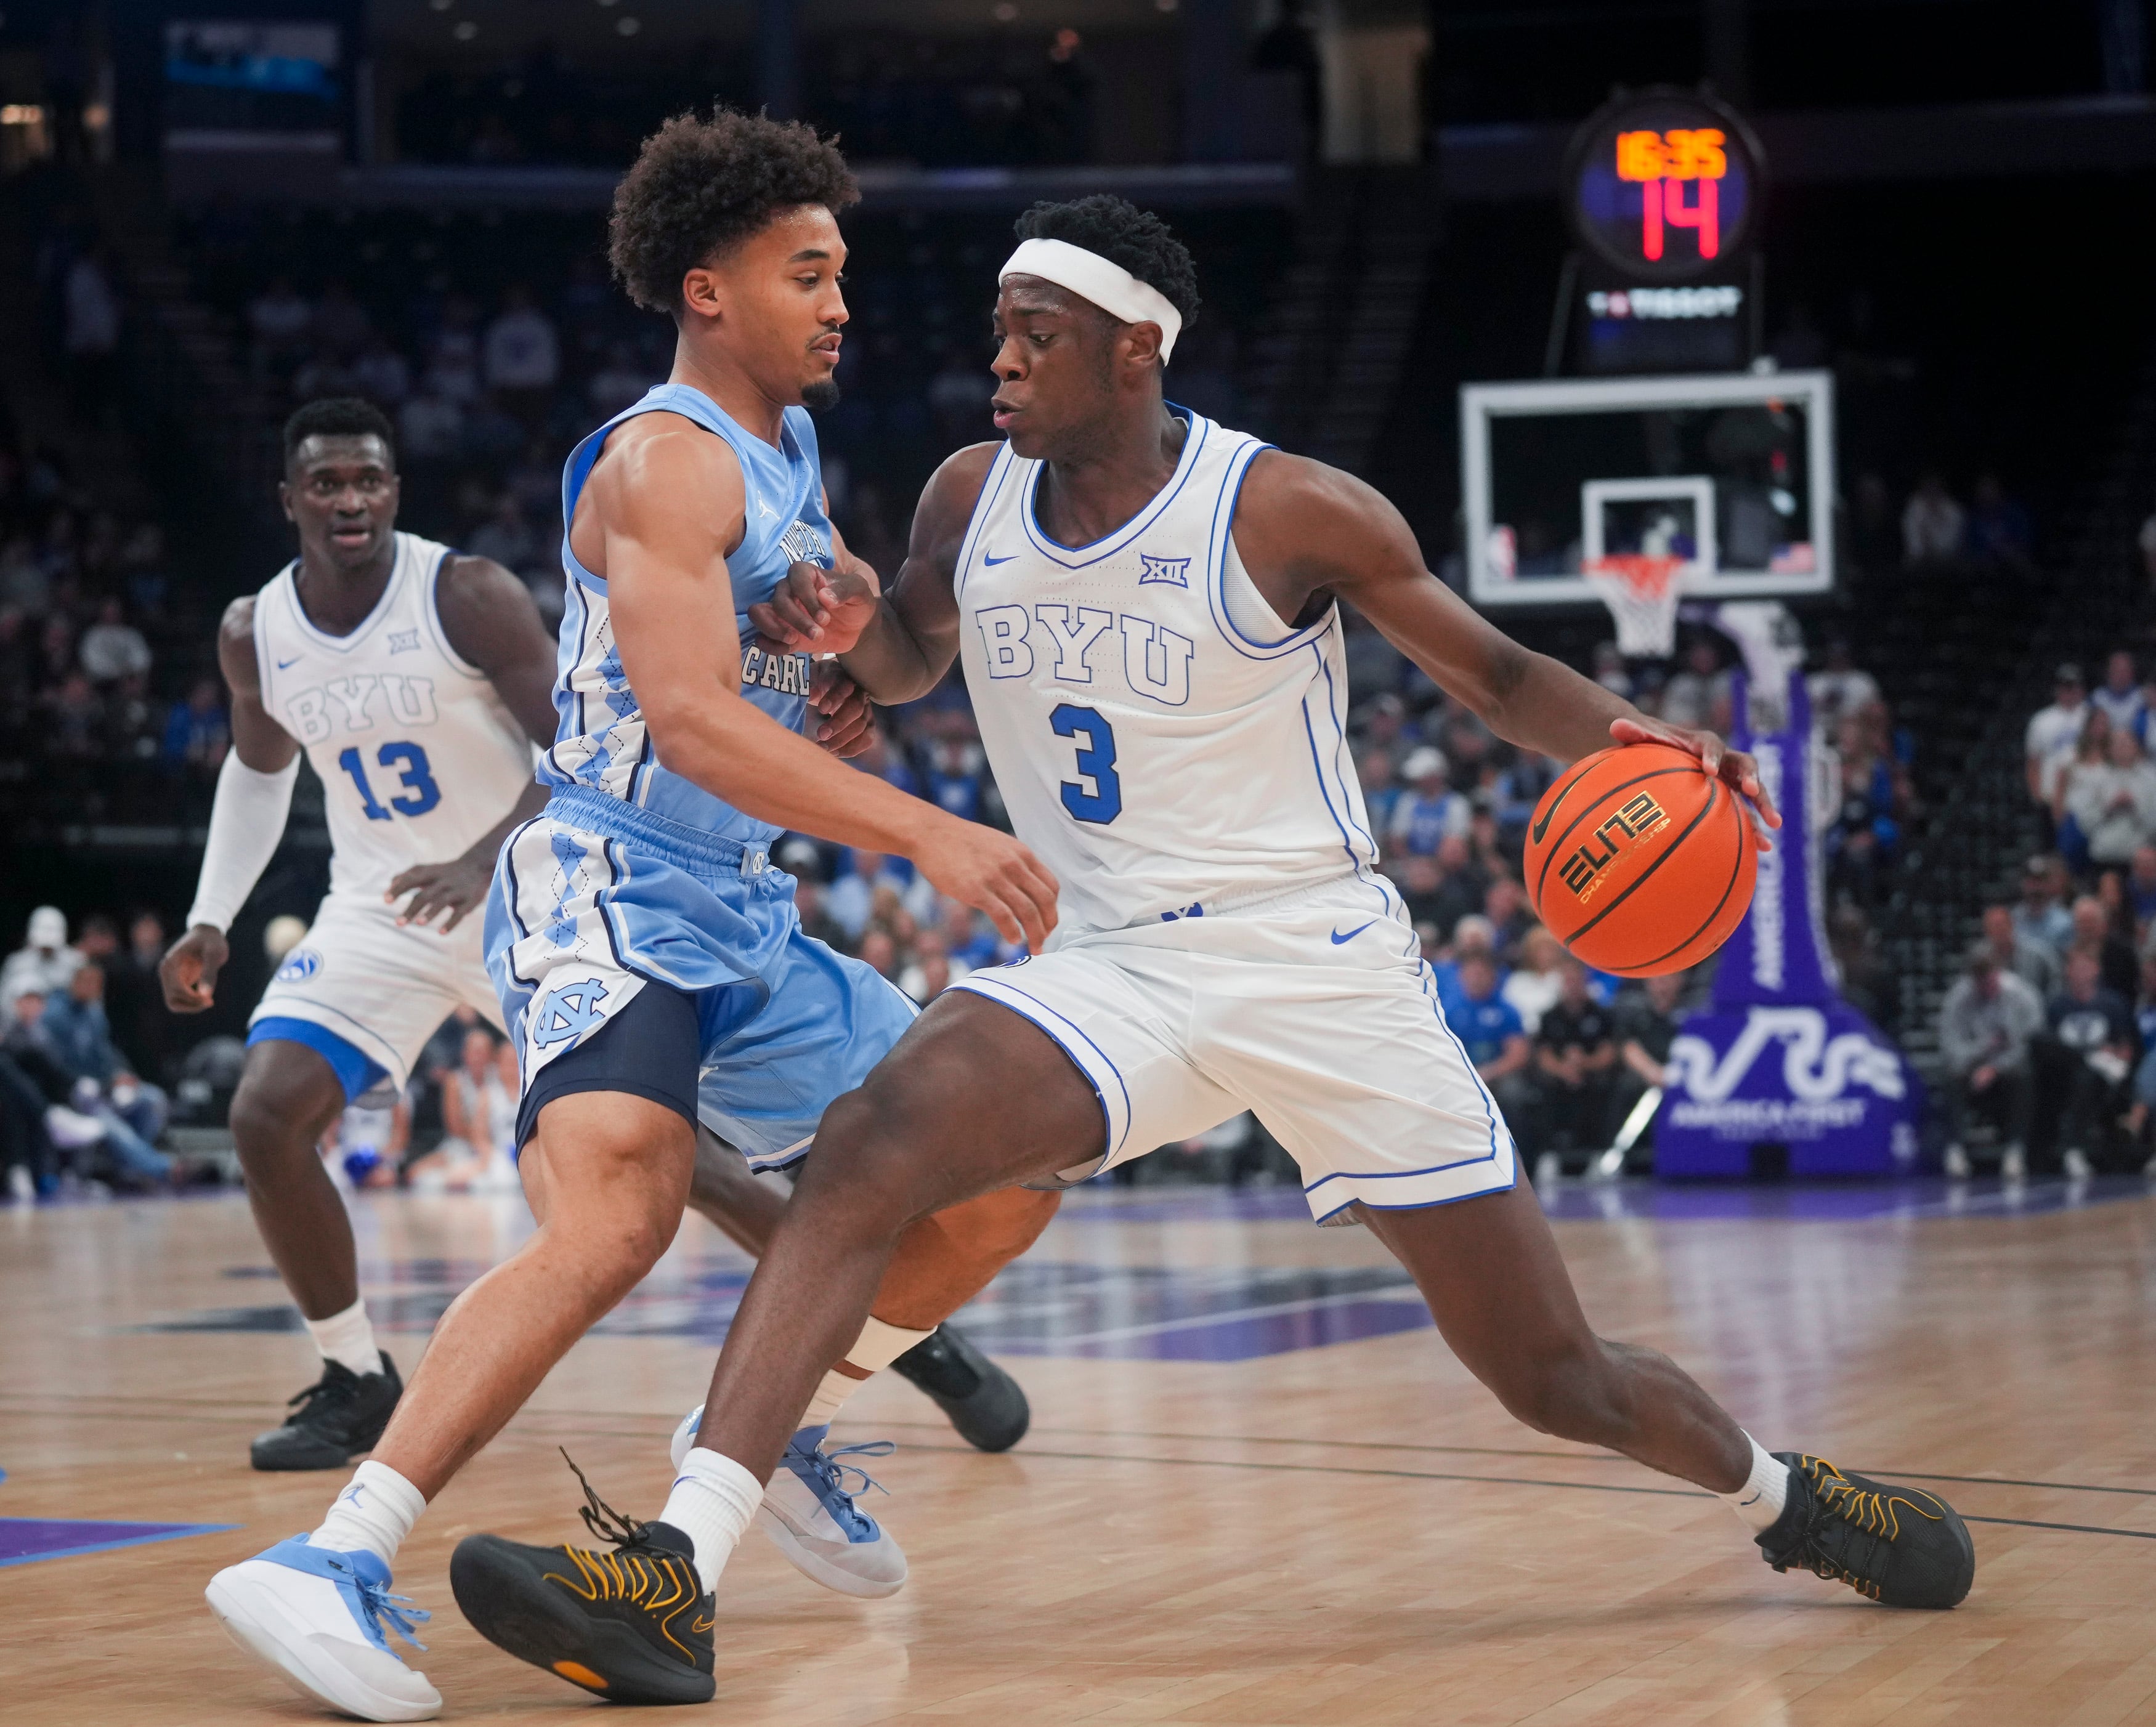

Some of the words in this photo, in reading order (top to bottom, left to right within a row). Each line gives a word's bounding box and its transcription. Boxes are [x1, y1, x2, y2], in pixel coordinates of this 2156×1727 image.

[1642, 177, 1719, 261] 14
[975, 604, 1194, 706] BYU
[286, 673, 439, 746] BYU
[339, 741, 442, 821] 13
[1048, 703, 1122, 825] 3
